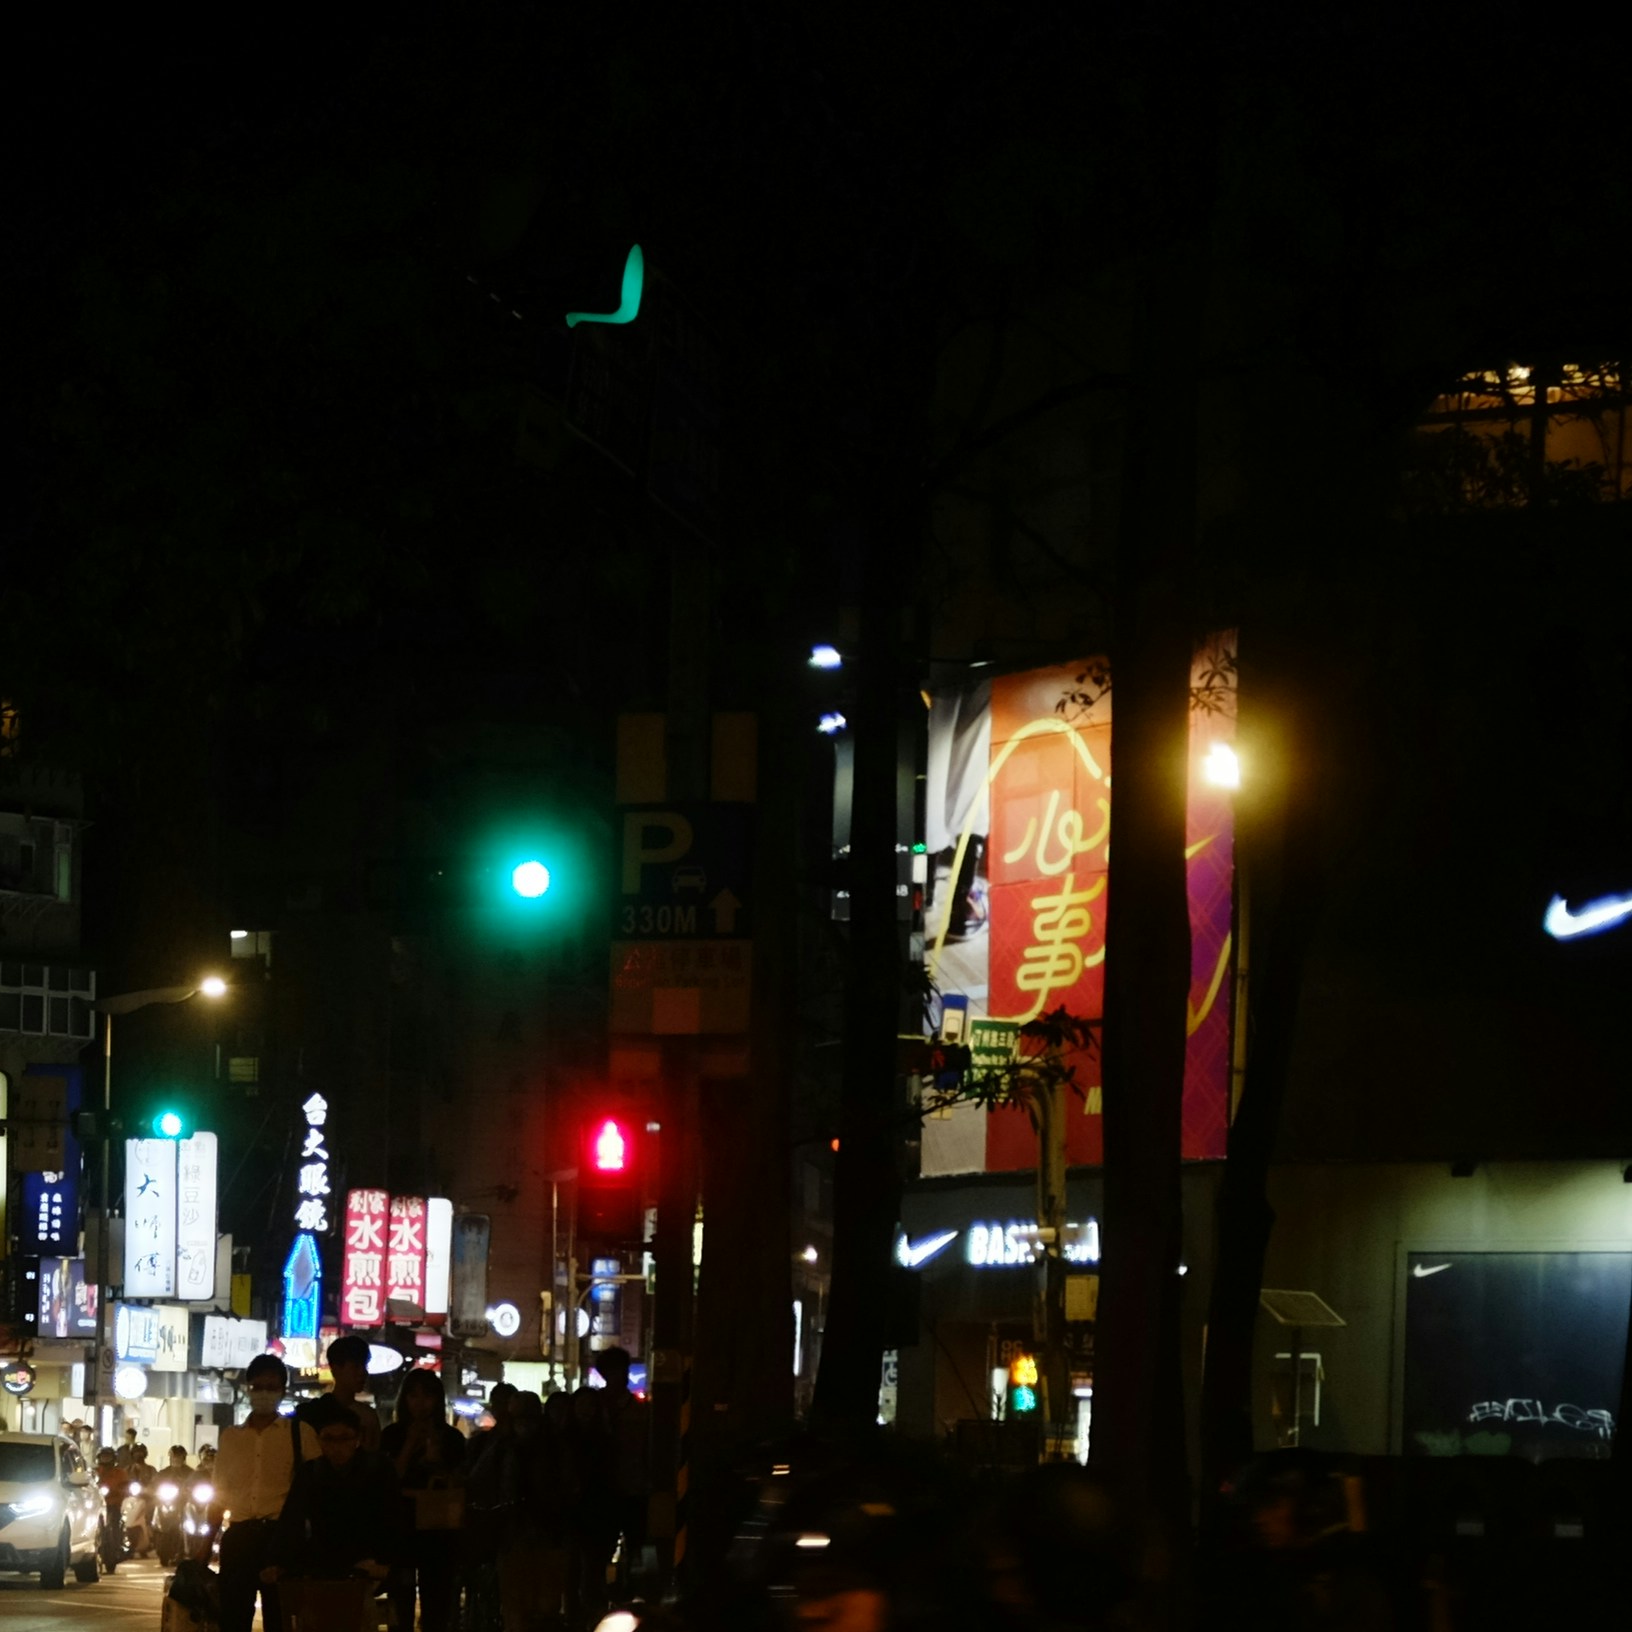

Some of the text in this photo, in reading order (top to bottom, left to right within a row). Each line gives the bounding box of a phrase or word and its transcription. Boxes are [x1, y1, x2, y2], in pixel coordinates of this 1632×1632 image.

[621, 810, 695, 896] P
[621, 904, 697, 934] 330M
[182, 1164, 201, 1227] 綠豆沙
[294, 1092, 332, 1232] 台大眼鏡
[344, 1215, 385, 1322] 水煎包
